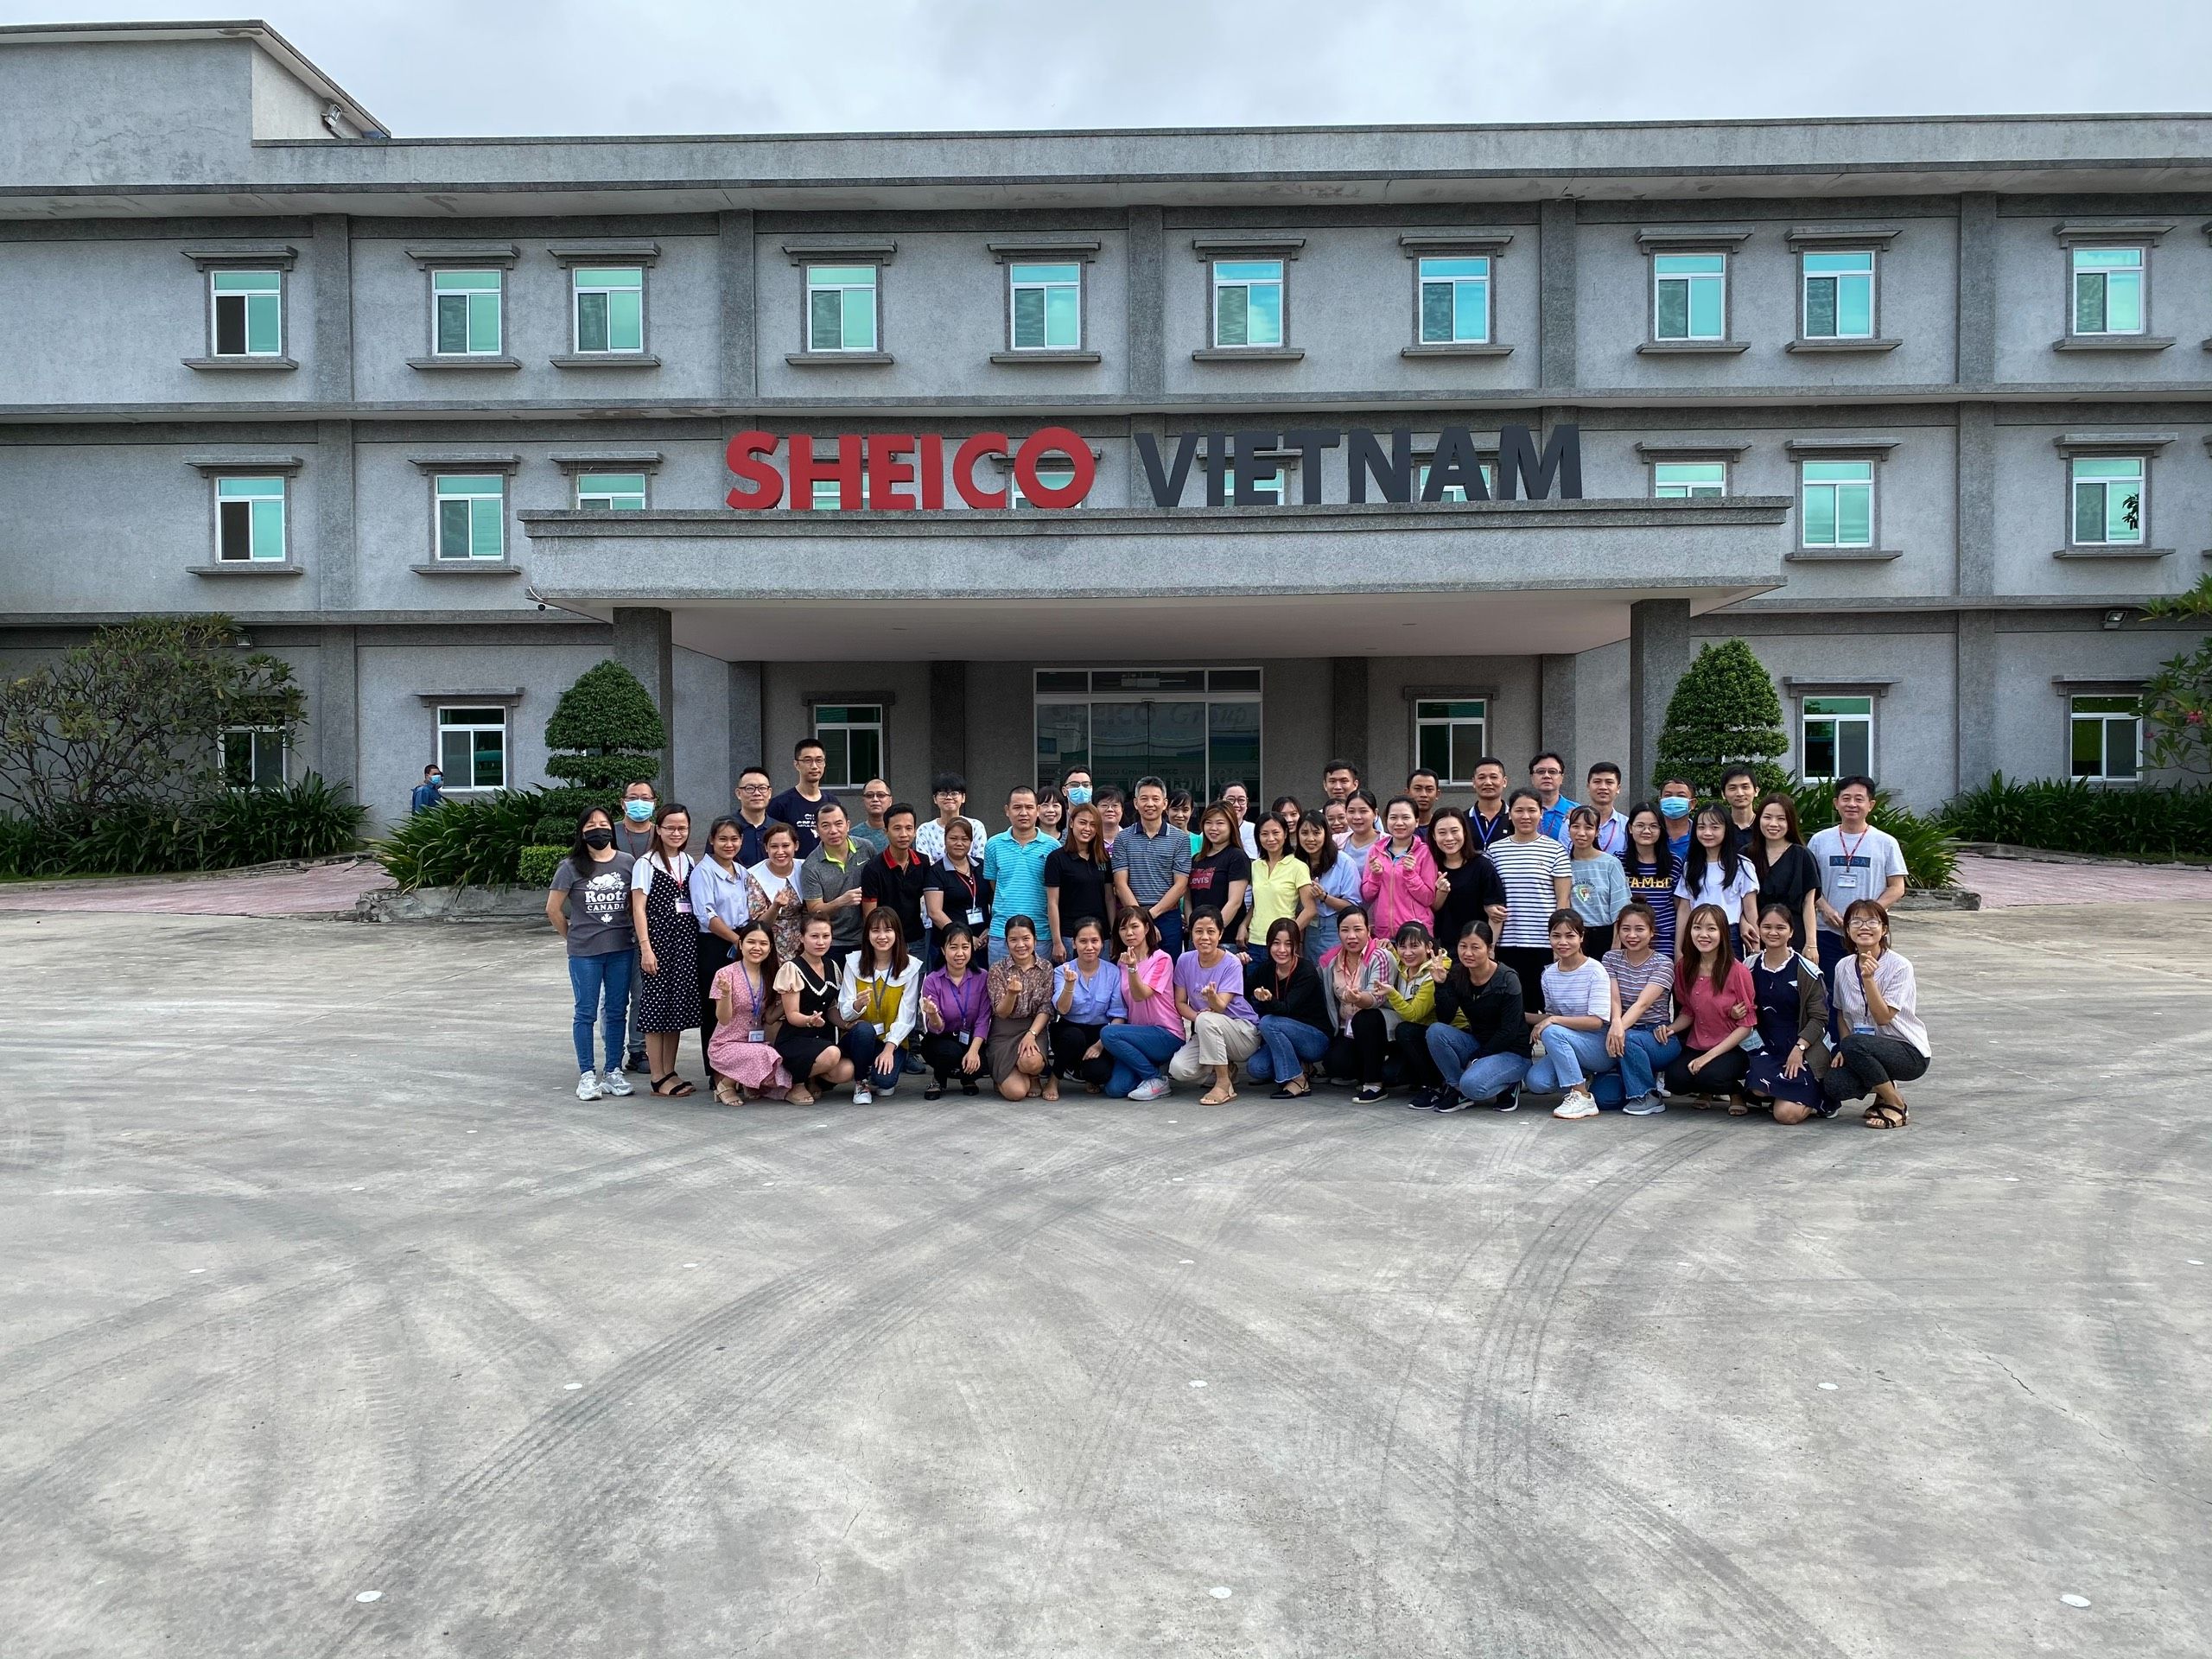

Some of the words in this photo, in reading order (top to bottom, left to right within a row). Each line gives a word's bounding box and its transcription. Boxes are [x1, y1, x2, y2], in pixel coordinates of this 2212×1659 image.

[726, 427, 1095, 510] SHEICO
[1135, 424, 1584, 507] VIETNAM
[584, 890, 627, 903] Roots
[587, 903, 625, 912] CANADA
